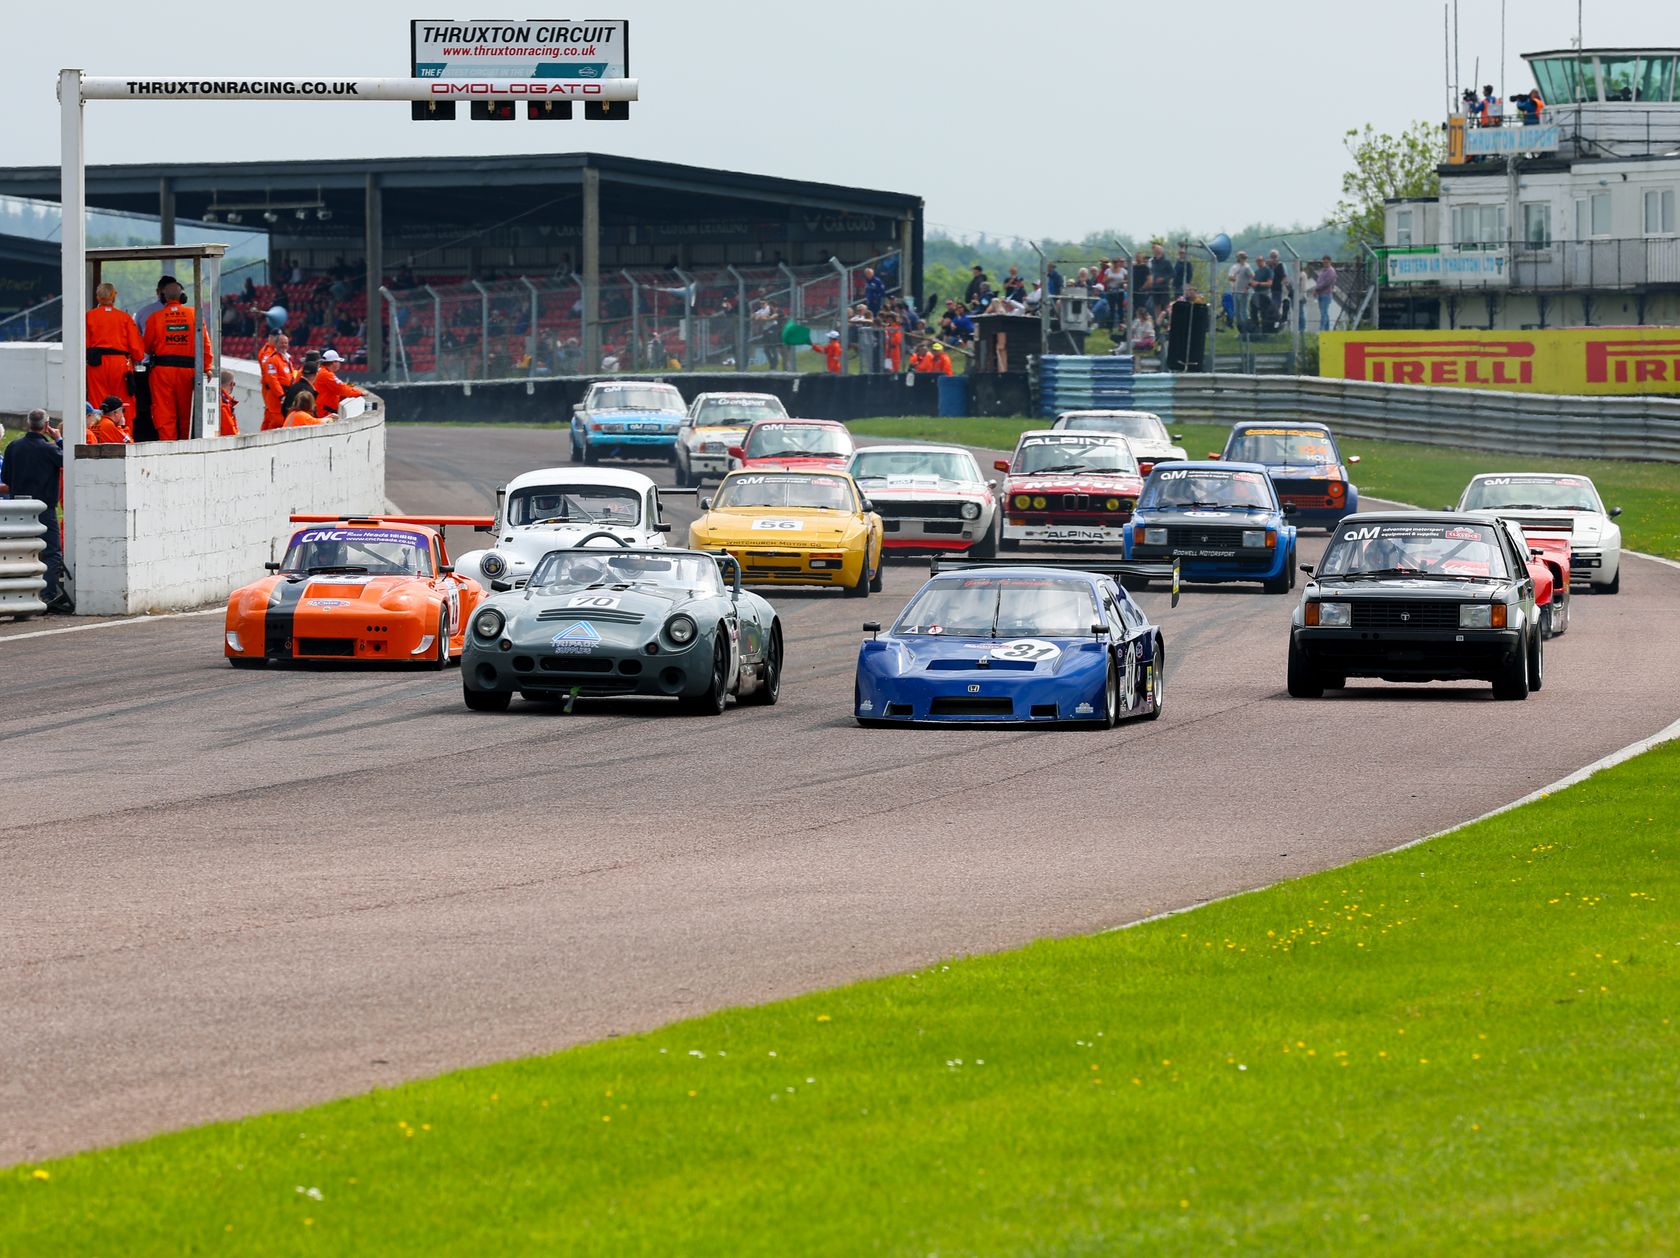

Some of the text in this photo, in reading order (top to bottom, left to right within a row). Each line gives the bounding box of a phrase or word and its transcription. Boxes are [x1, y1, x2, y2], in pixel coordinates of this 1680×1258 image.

[423, 27, 616, 43] THRUXTON CIRCUIT
[443, 45, 596, 58] www.thruxtonracing.co.uk
[127, 81, 359, 95] THRUXTONRACING.CO.UK
[432, 83, 601, 94] OMOLOGATO
[1518, 127, 1558, 148] AIRPORT
[166, 335, 189, 343] NGK
[1344, 341, 1535, 384] PIRELLI
[1022, 437, 1124, 447] ALPINA
[1024, 481, 1129, 491] MOTUL
[760, 520, 796, 529] 56
[301, 531, 347, 543] CNC
[1048, 531, 1104, 539] ALPINA
[346, 537, 417, 545] www.cncheads.co.uk
[576, 597, 615, 607] 70
[1004, 643, 1055, 660] 31
